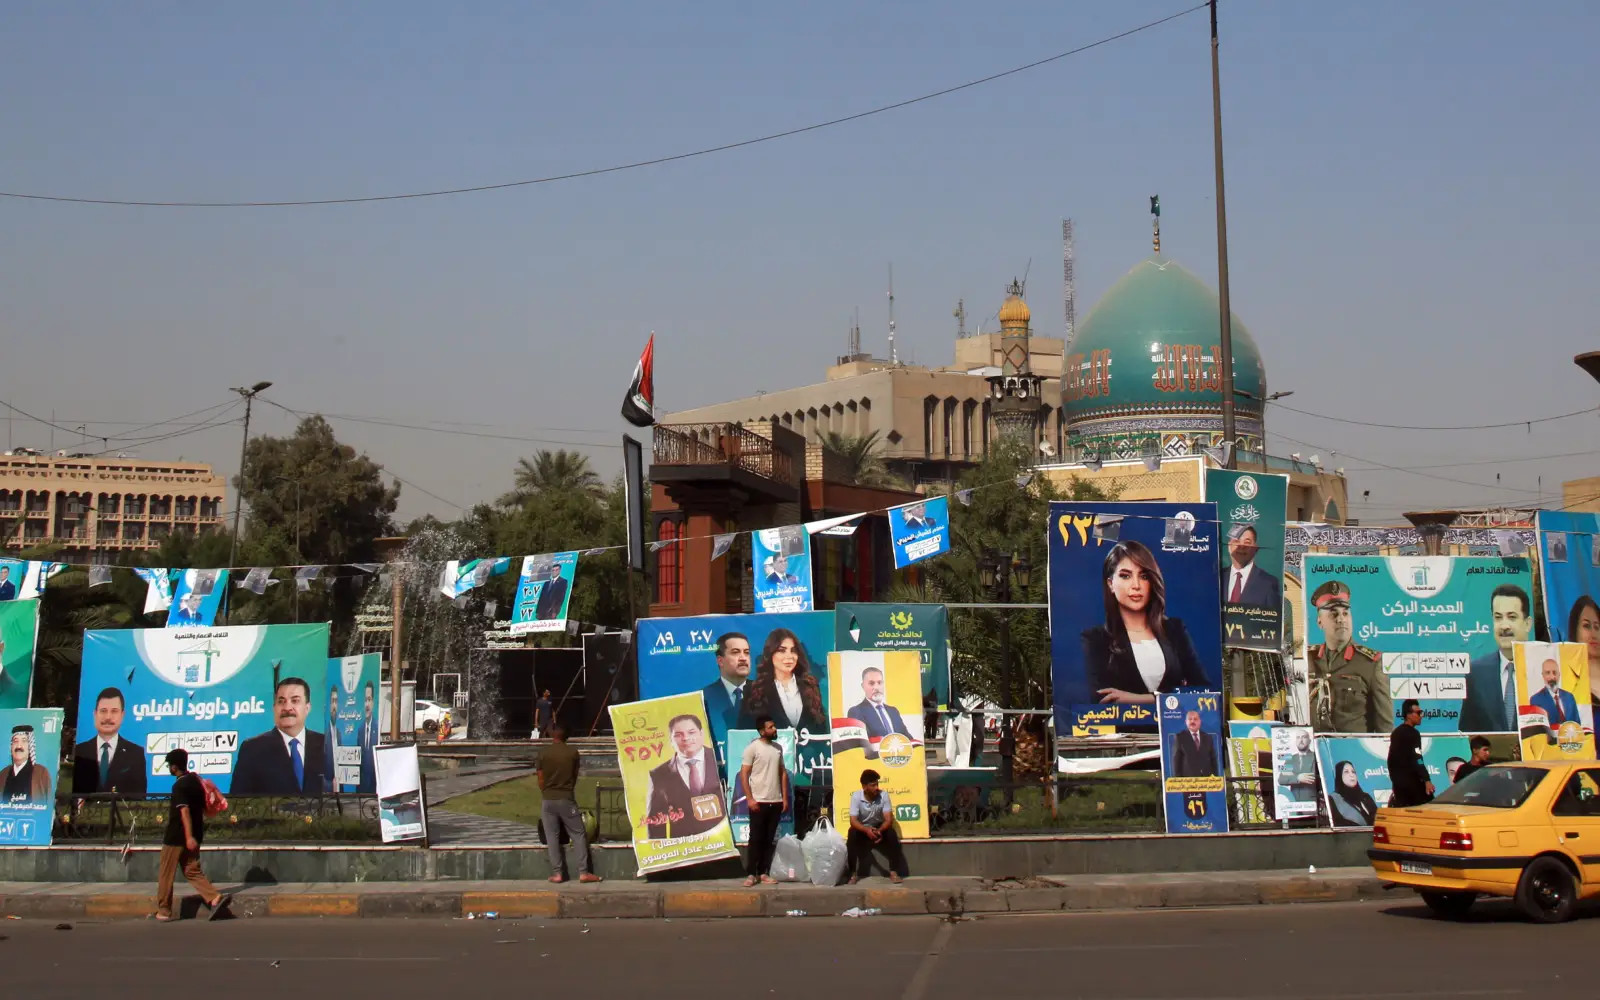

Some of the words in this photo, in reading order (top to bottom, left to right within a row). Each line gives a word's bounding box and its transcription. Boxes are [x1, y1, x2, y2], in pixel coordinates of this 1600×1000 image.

[1311, 564, 1334, 574] البرلمان
[1347, 564, 1369, 573] الميدان
[1369, 566, 1379, 574] من
[1466, 566, 1485, 576] العام
[1382, 601, 1418, 616] الركن
[1421, 601, 1463, 614] العميد
[656, 631, 674, 646] ٨٩
[690, 629, 713, 644] ٢٠٧
[1359, 622, 1413, 640] السراي
[1460, 622, 1490, 642] علي
[649, 646, 681, 655] التسلسل
[1449, 658, 1466, 669] ٢٠٧
[1414, 681, 1430, 694] ٧٦
[1440, 683, 1463, 692] التسلسل
[133, 698, 183, 721] الفيلي
[186, 697, 229, 720] داوود
[231, 696, 265, 719] عامر
[1122, 705, 1151, 722] حاتم
[1422, 709, 1441, 719] القوا
[1077, 705, 1119, 729] التميمي
[1441, 711, 1458, 719] صوت
[215, 734, 236, 747] ٢٠٧
[624, 741, 664, 762] ٢٥٧
[188, 760, 195, 769] ٥
[204, 758, 230, 767] التسلسل
[11, 793, 27, 802] الشيخ
[1188, 800, 1205, 816] ٩٦
[642, 849, 680, 864] الموسوي
[682, 846, 703, 856] عادل
